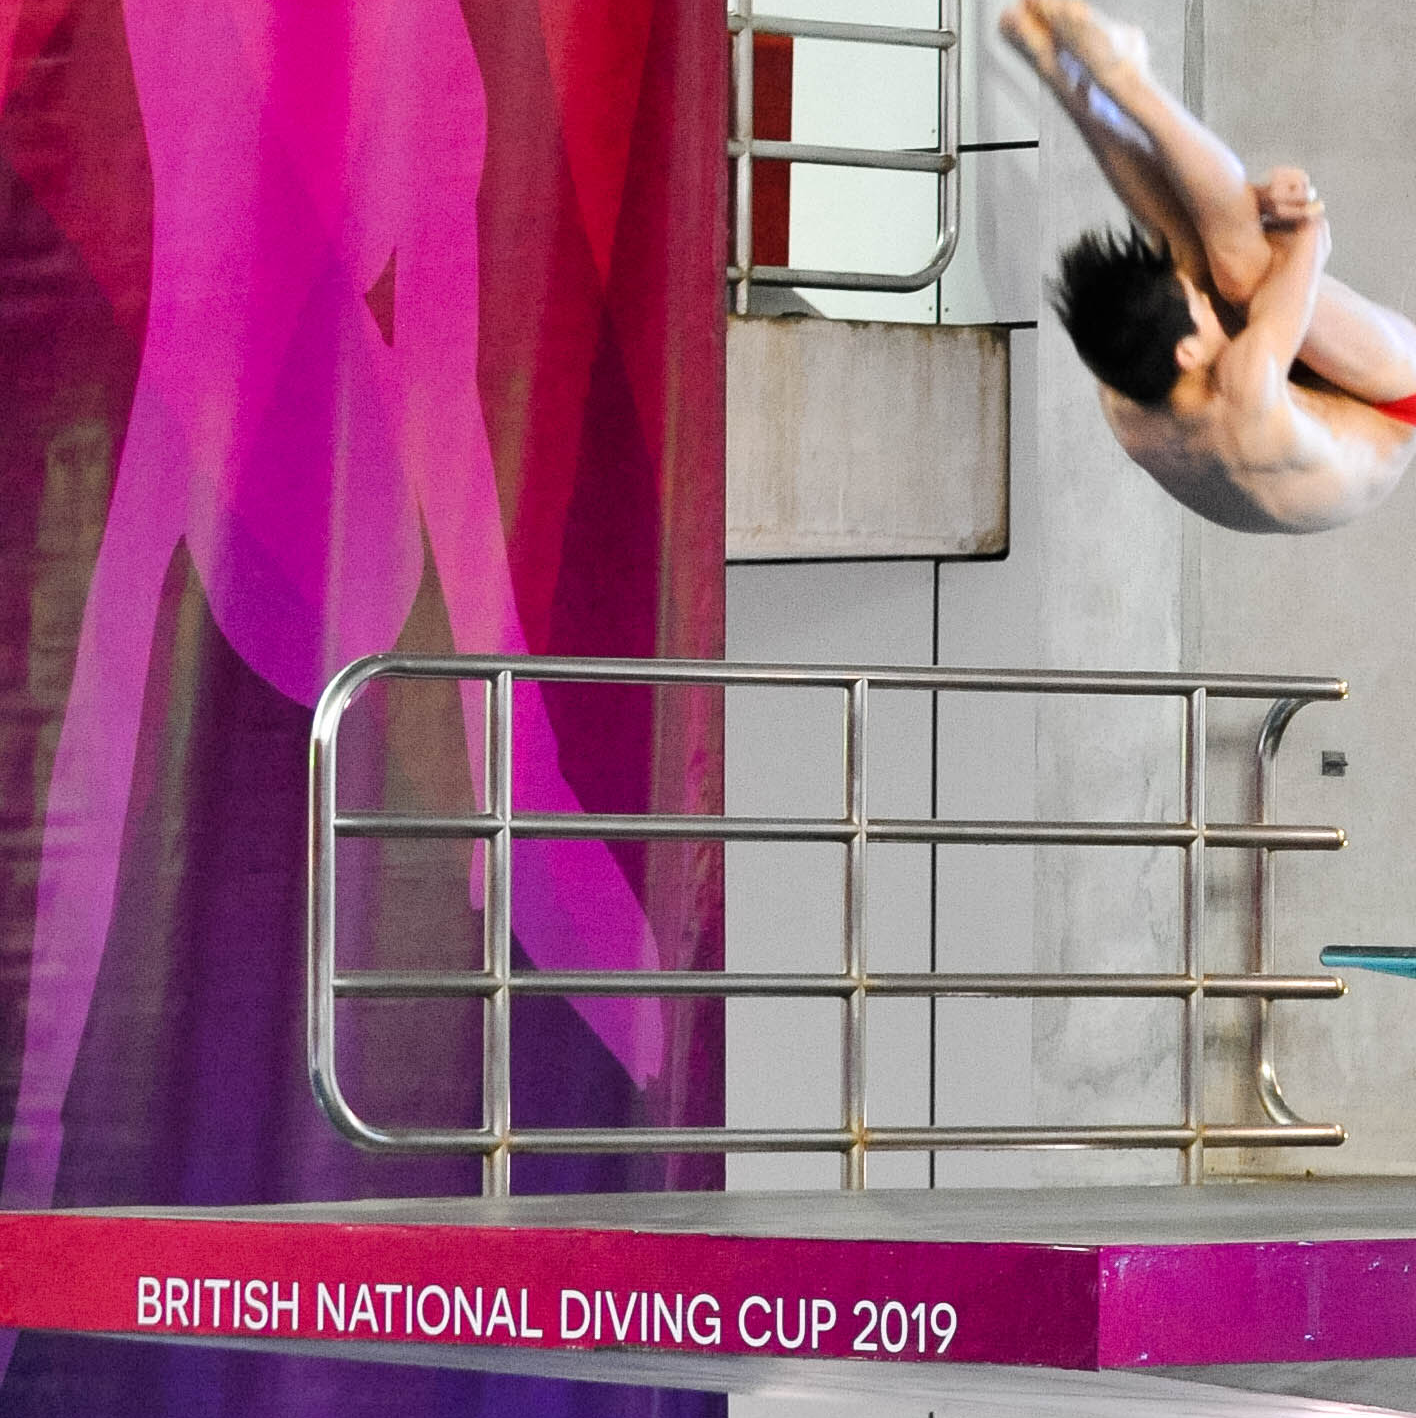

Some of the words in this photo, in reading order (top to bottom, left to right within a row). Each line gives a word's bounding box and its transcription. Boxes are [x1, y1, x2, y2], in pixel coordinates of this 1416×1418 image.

[138, 1276, 299, 1331] BRITISH
[317, 1283, 543, 1339] NATIONAL
[561, 1289, 721, 1345] DIVING
[738, 1295, 837, 1350] CUP
[853, 1300, 957, 1354] 2019
